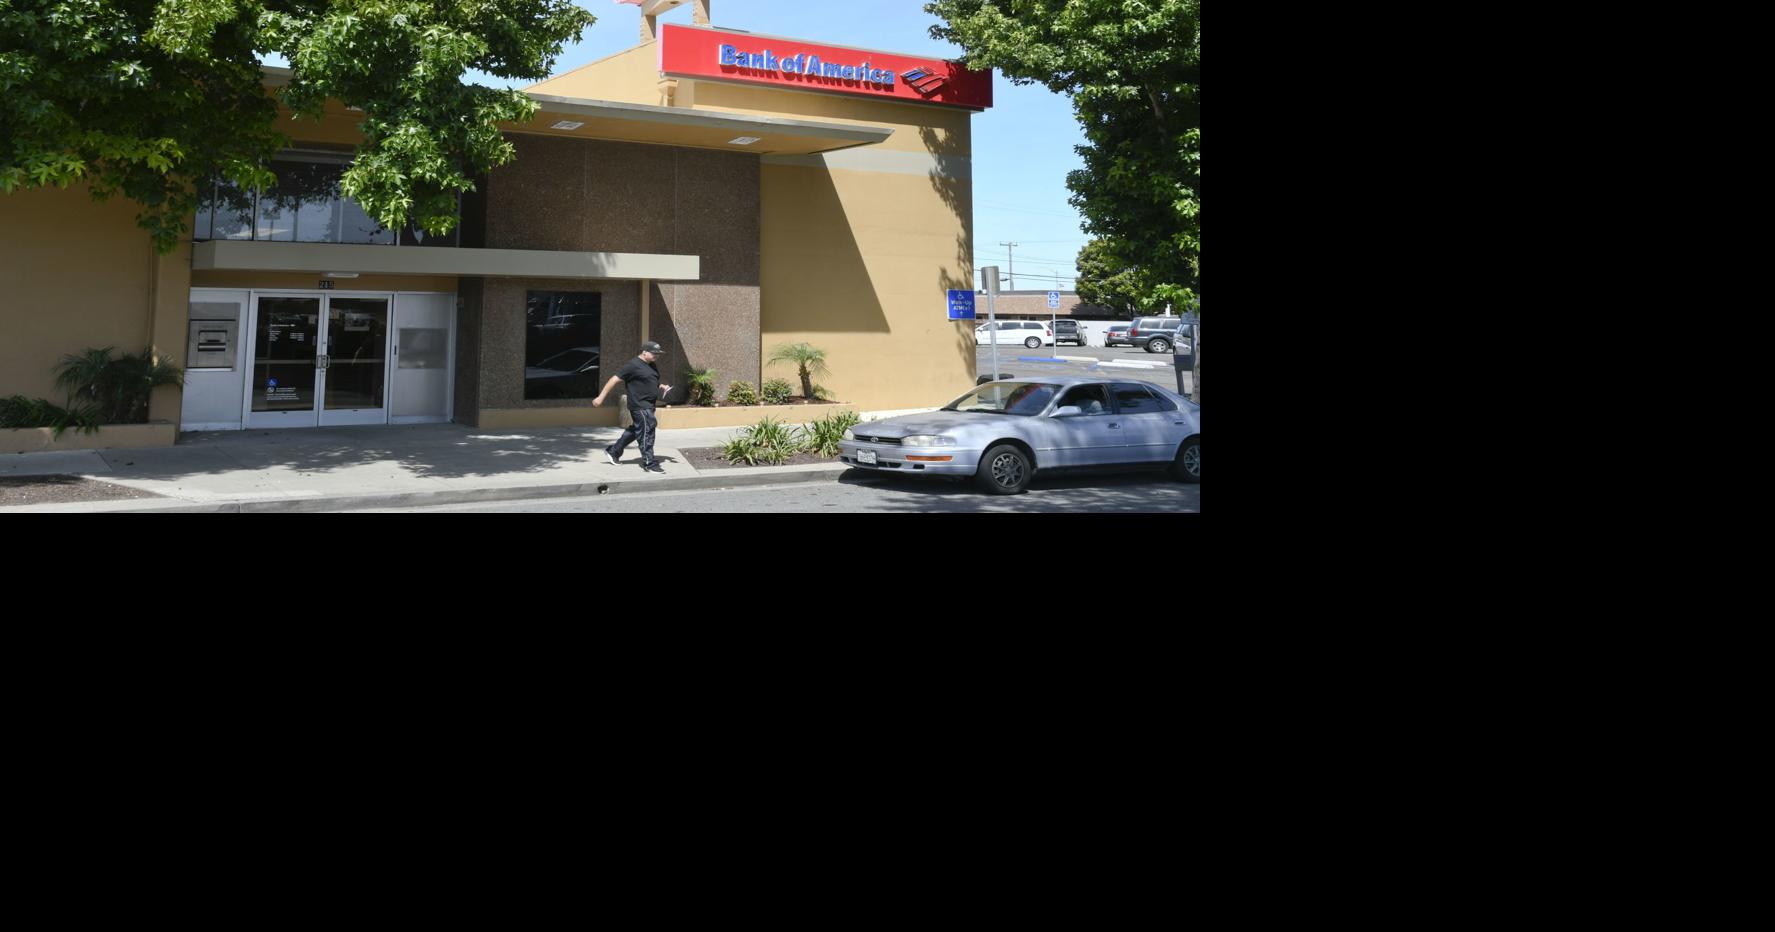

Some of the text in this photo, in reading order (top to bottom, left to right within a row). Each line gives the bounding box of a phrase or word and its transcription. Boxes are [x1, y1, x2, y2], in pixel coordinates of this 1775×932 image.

[719, 44, 895, 85] Bank of America
